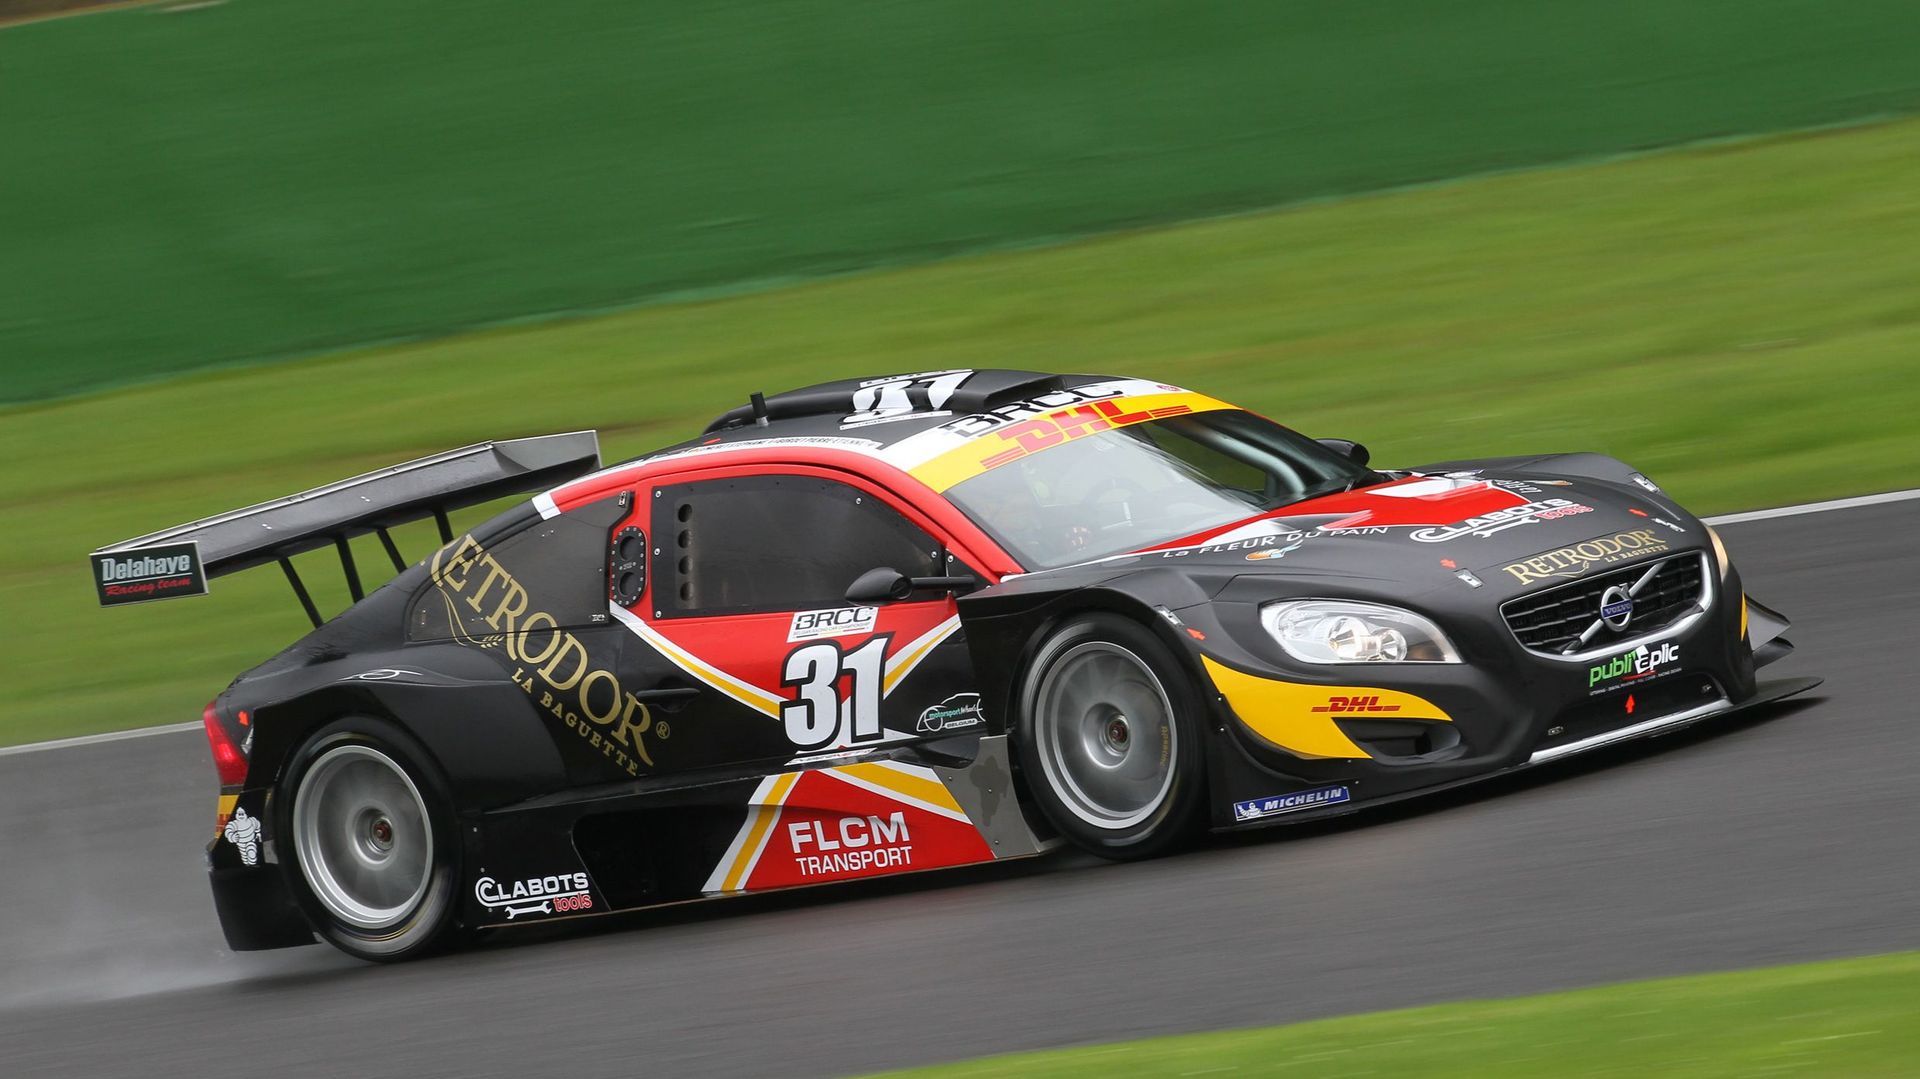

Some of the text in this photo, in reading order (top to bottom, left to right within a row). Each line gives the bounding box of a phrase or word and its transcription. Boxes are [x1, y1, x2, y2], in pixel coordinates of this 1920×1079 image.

[996, 400, 1154, 454] DHL
[1409, 498, 1575, 543] CLABOTS
[1199, 535, 1276, 555] FLEUR
[1286, 529, 1322, 543] DU
[1330, 526, 1389, 537] PAIN
[1621, 544, 1669, 560] BAGUETTE
[101, 554, 191, 581] Delahaye
[1502, 528, 1667, 586] RETRODOR
[104, 577, 192, 597] Racing team
[795, 606, 874, 631] BRCC
[1604, 602, 1632, 615] VOLVO
[782, 636, 890, 748] 31
[1328, 696, 1383, 712] DHL
[511, 667, 638, 777] LA BAGUETTE
[1264, 787, 1342, 812] MICHELIN
[787, 811, 910, 854] FLCM
[795, 846, 912, 875] TRANSPORT
[475, 872, 589, 907] CLABOTS
[553, 892, 593, 912] tools
